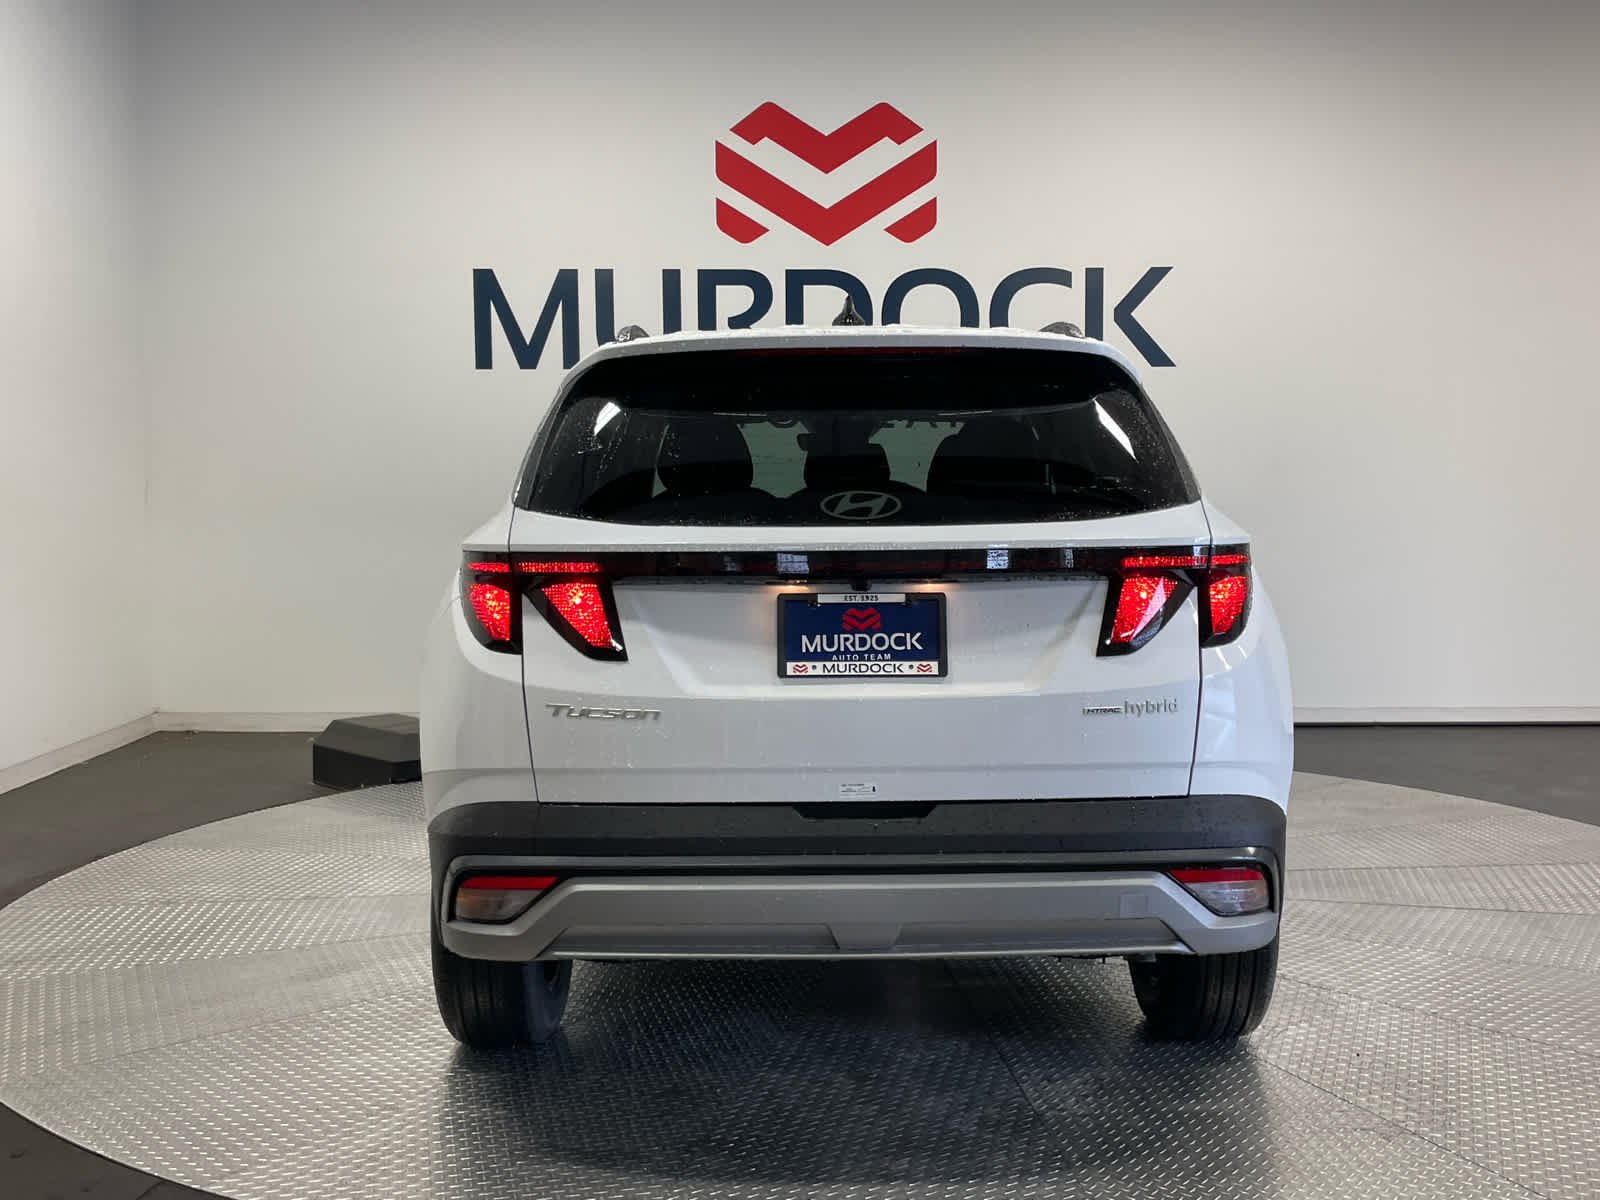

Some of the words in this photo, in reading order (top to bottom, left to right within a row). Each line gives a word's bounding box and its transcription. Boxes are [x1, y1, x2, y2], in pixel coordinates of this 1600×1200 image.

[472, 266, 1176, 369] MURDOCK
[801, 632, 923, 653] MURDOCK
[822, 662, 904, 673] MURDOCK
[1124, 698, 1178, 717] hybrid
